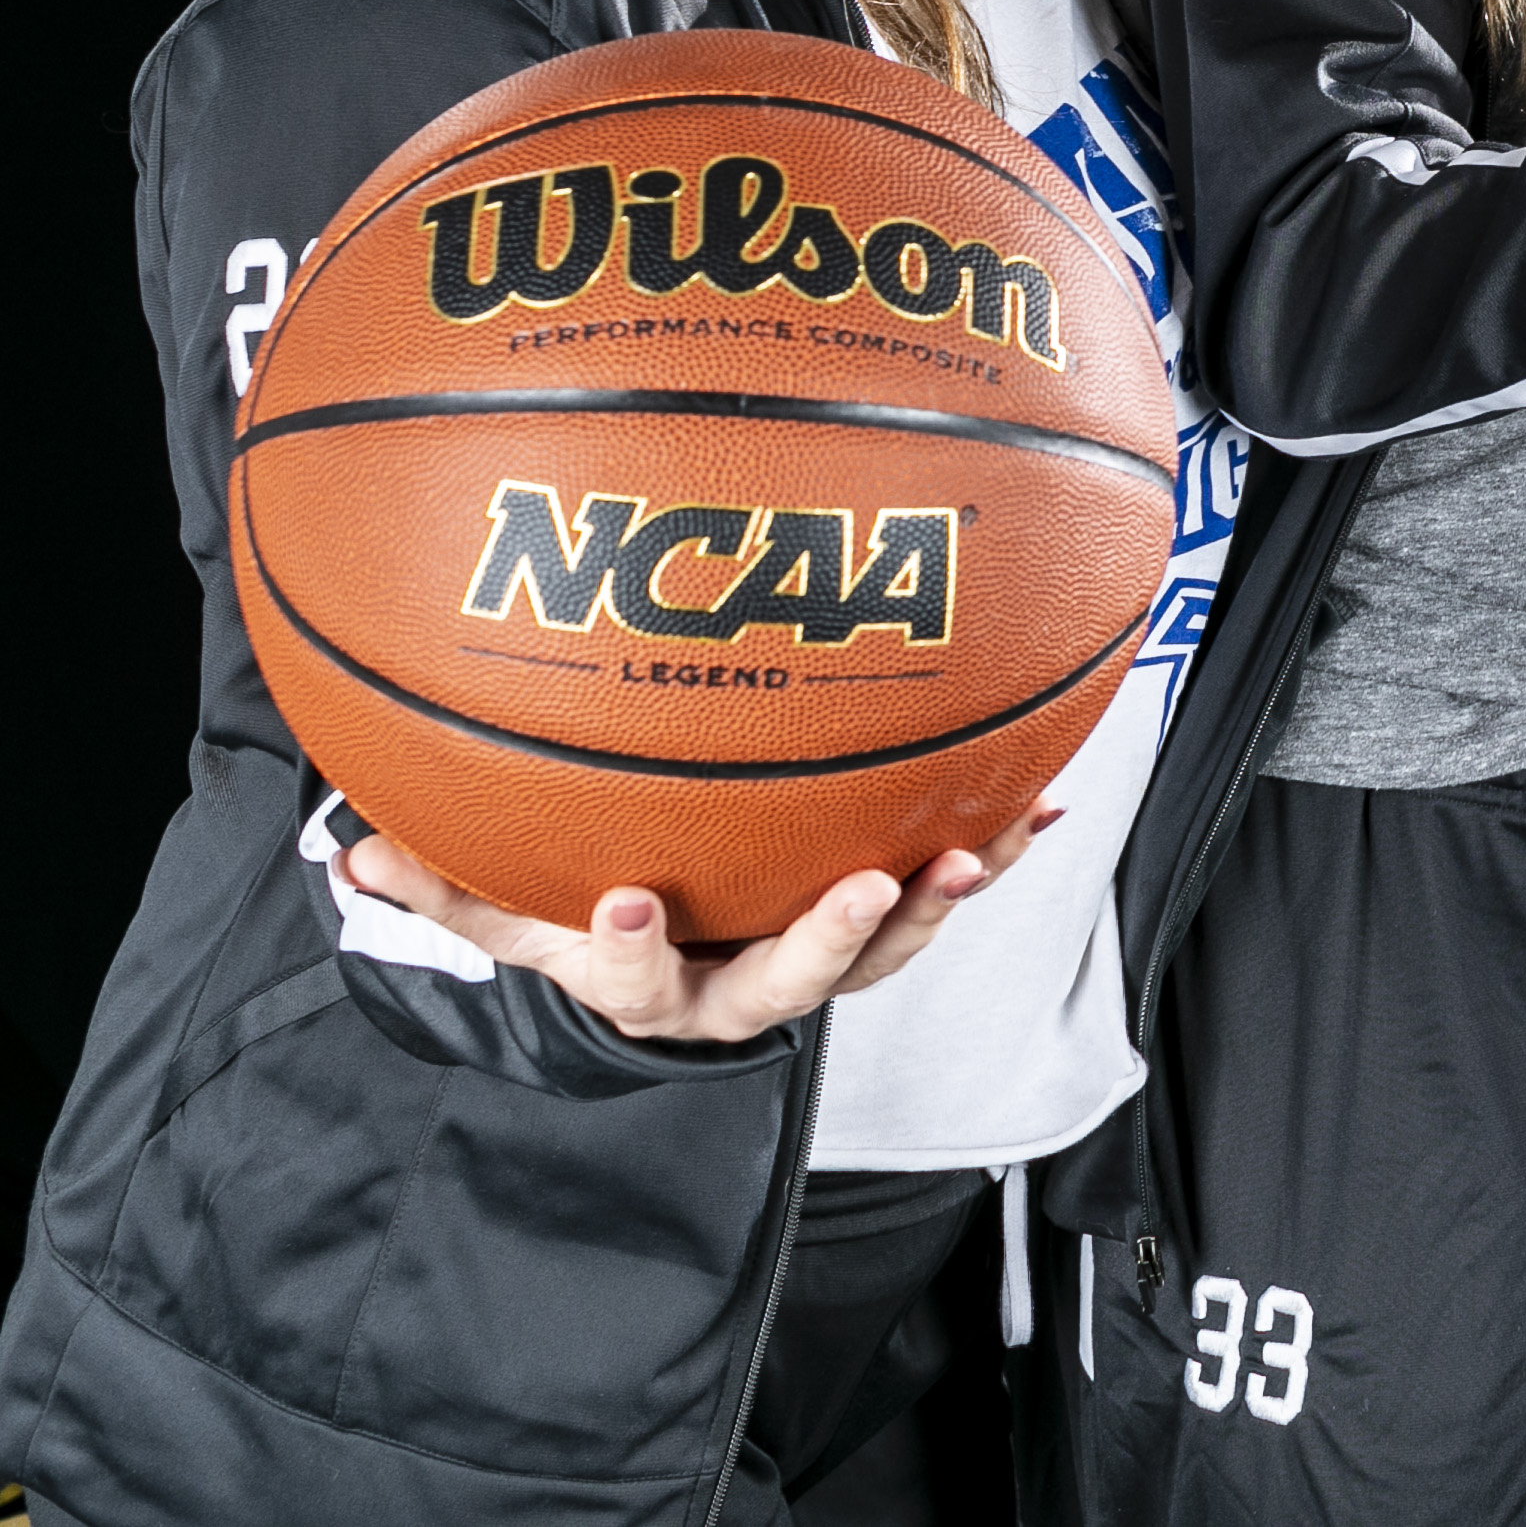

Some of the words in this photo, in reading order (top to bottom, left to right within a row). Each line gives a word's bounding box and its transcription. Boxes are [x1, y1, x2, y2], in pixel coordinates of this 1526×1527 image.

[226, 238, 319, 397] 2
[420, 155, 1066, 372] Wilson
[508, 317, 793, 353] PERFORMANCE
[807, 324, 1002, 385] COMPOSITE
[460, 479, 958, 647] NCAA
[620, 661, 790, 690] LEGEND
[1185, 1275, 1313, 1425] 33
